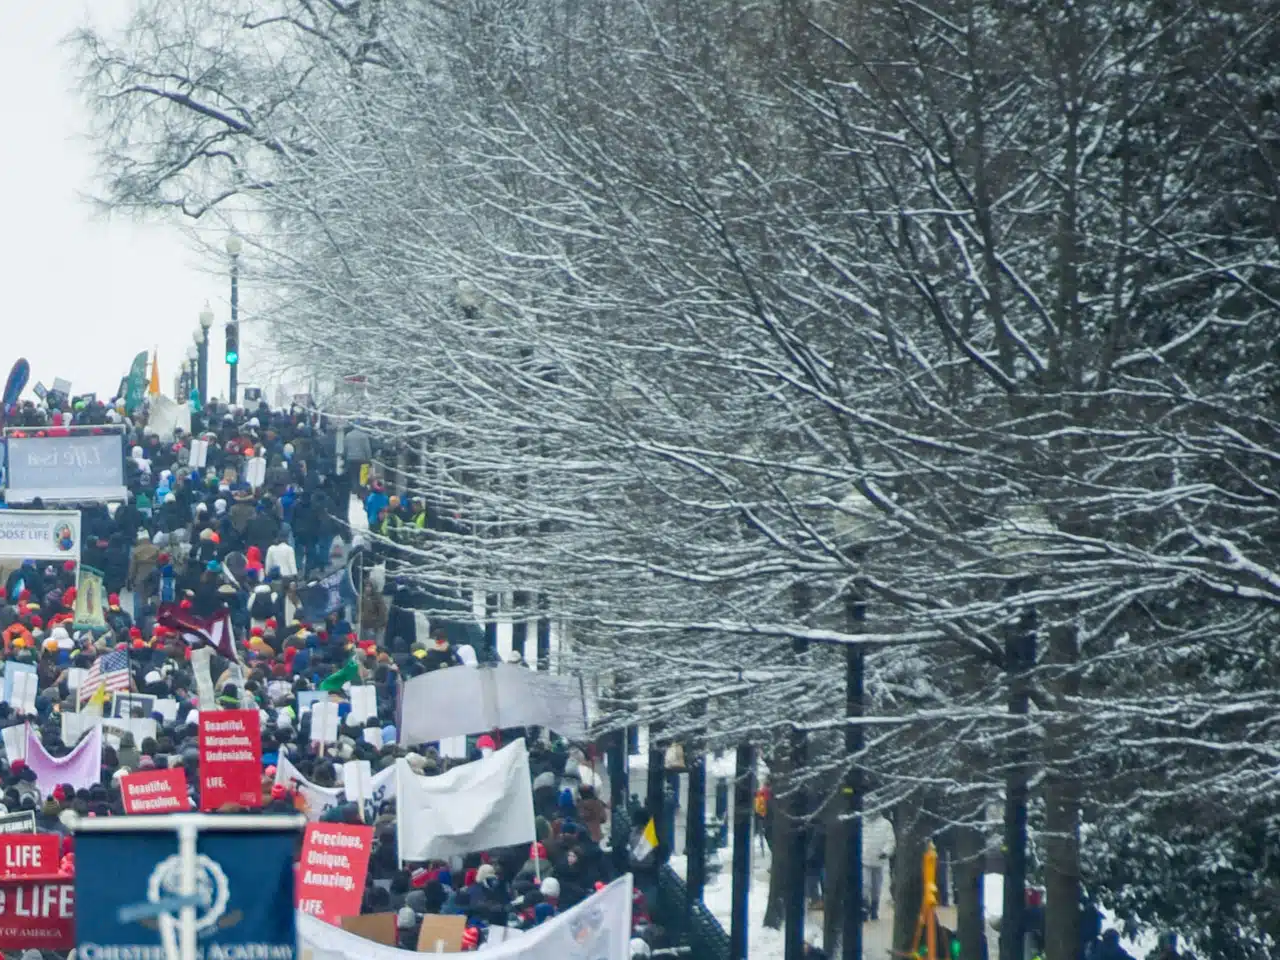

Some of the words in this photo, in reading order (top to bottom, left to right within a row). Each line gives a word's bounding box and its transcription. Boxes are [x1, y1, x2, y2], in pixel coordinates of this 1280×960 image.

[28, 530, 49, 540] LIFE
[6, 845, 41, 868] LIFE
[16, 883, 74, 918] LIFE
[5, 927, 17, 937] OF
[19, 927, 62, 938] AMERICA
